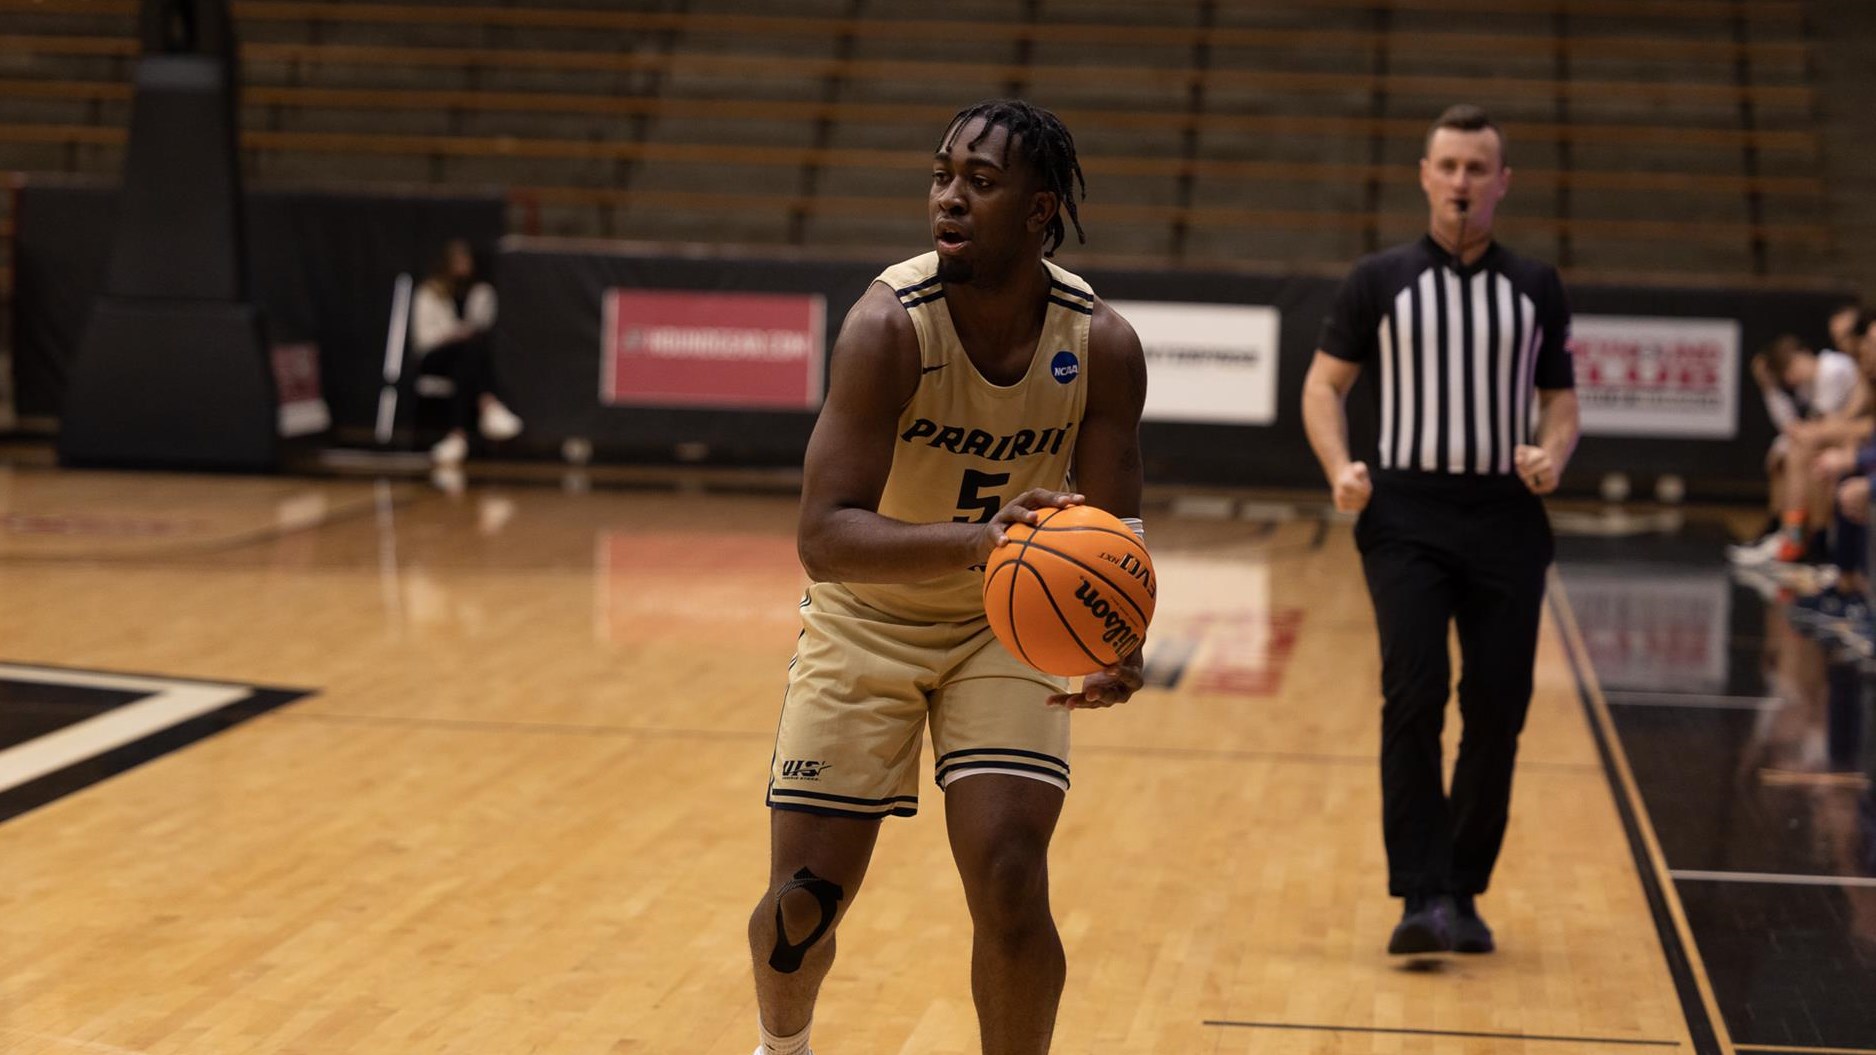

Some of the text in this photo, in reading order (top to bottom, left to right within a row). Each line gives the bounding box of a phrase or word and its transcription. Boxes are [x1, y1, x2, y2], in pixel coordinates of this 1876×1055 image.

[1054, 365, 1078, 376] NCAA
[952, 469, 1011, 523] 5
[1098, 553, 1120, 564] NXT
[1075, 580, 1140, 656] Wilson
